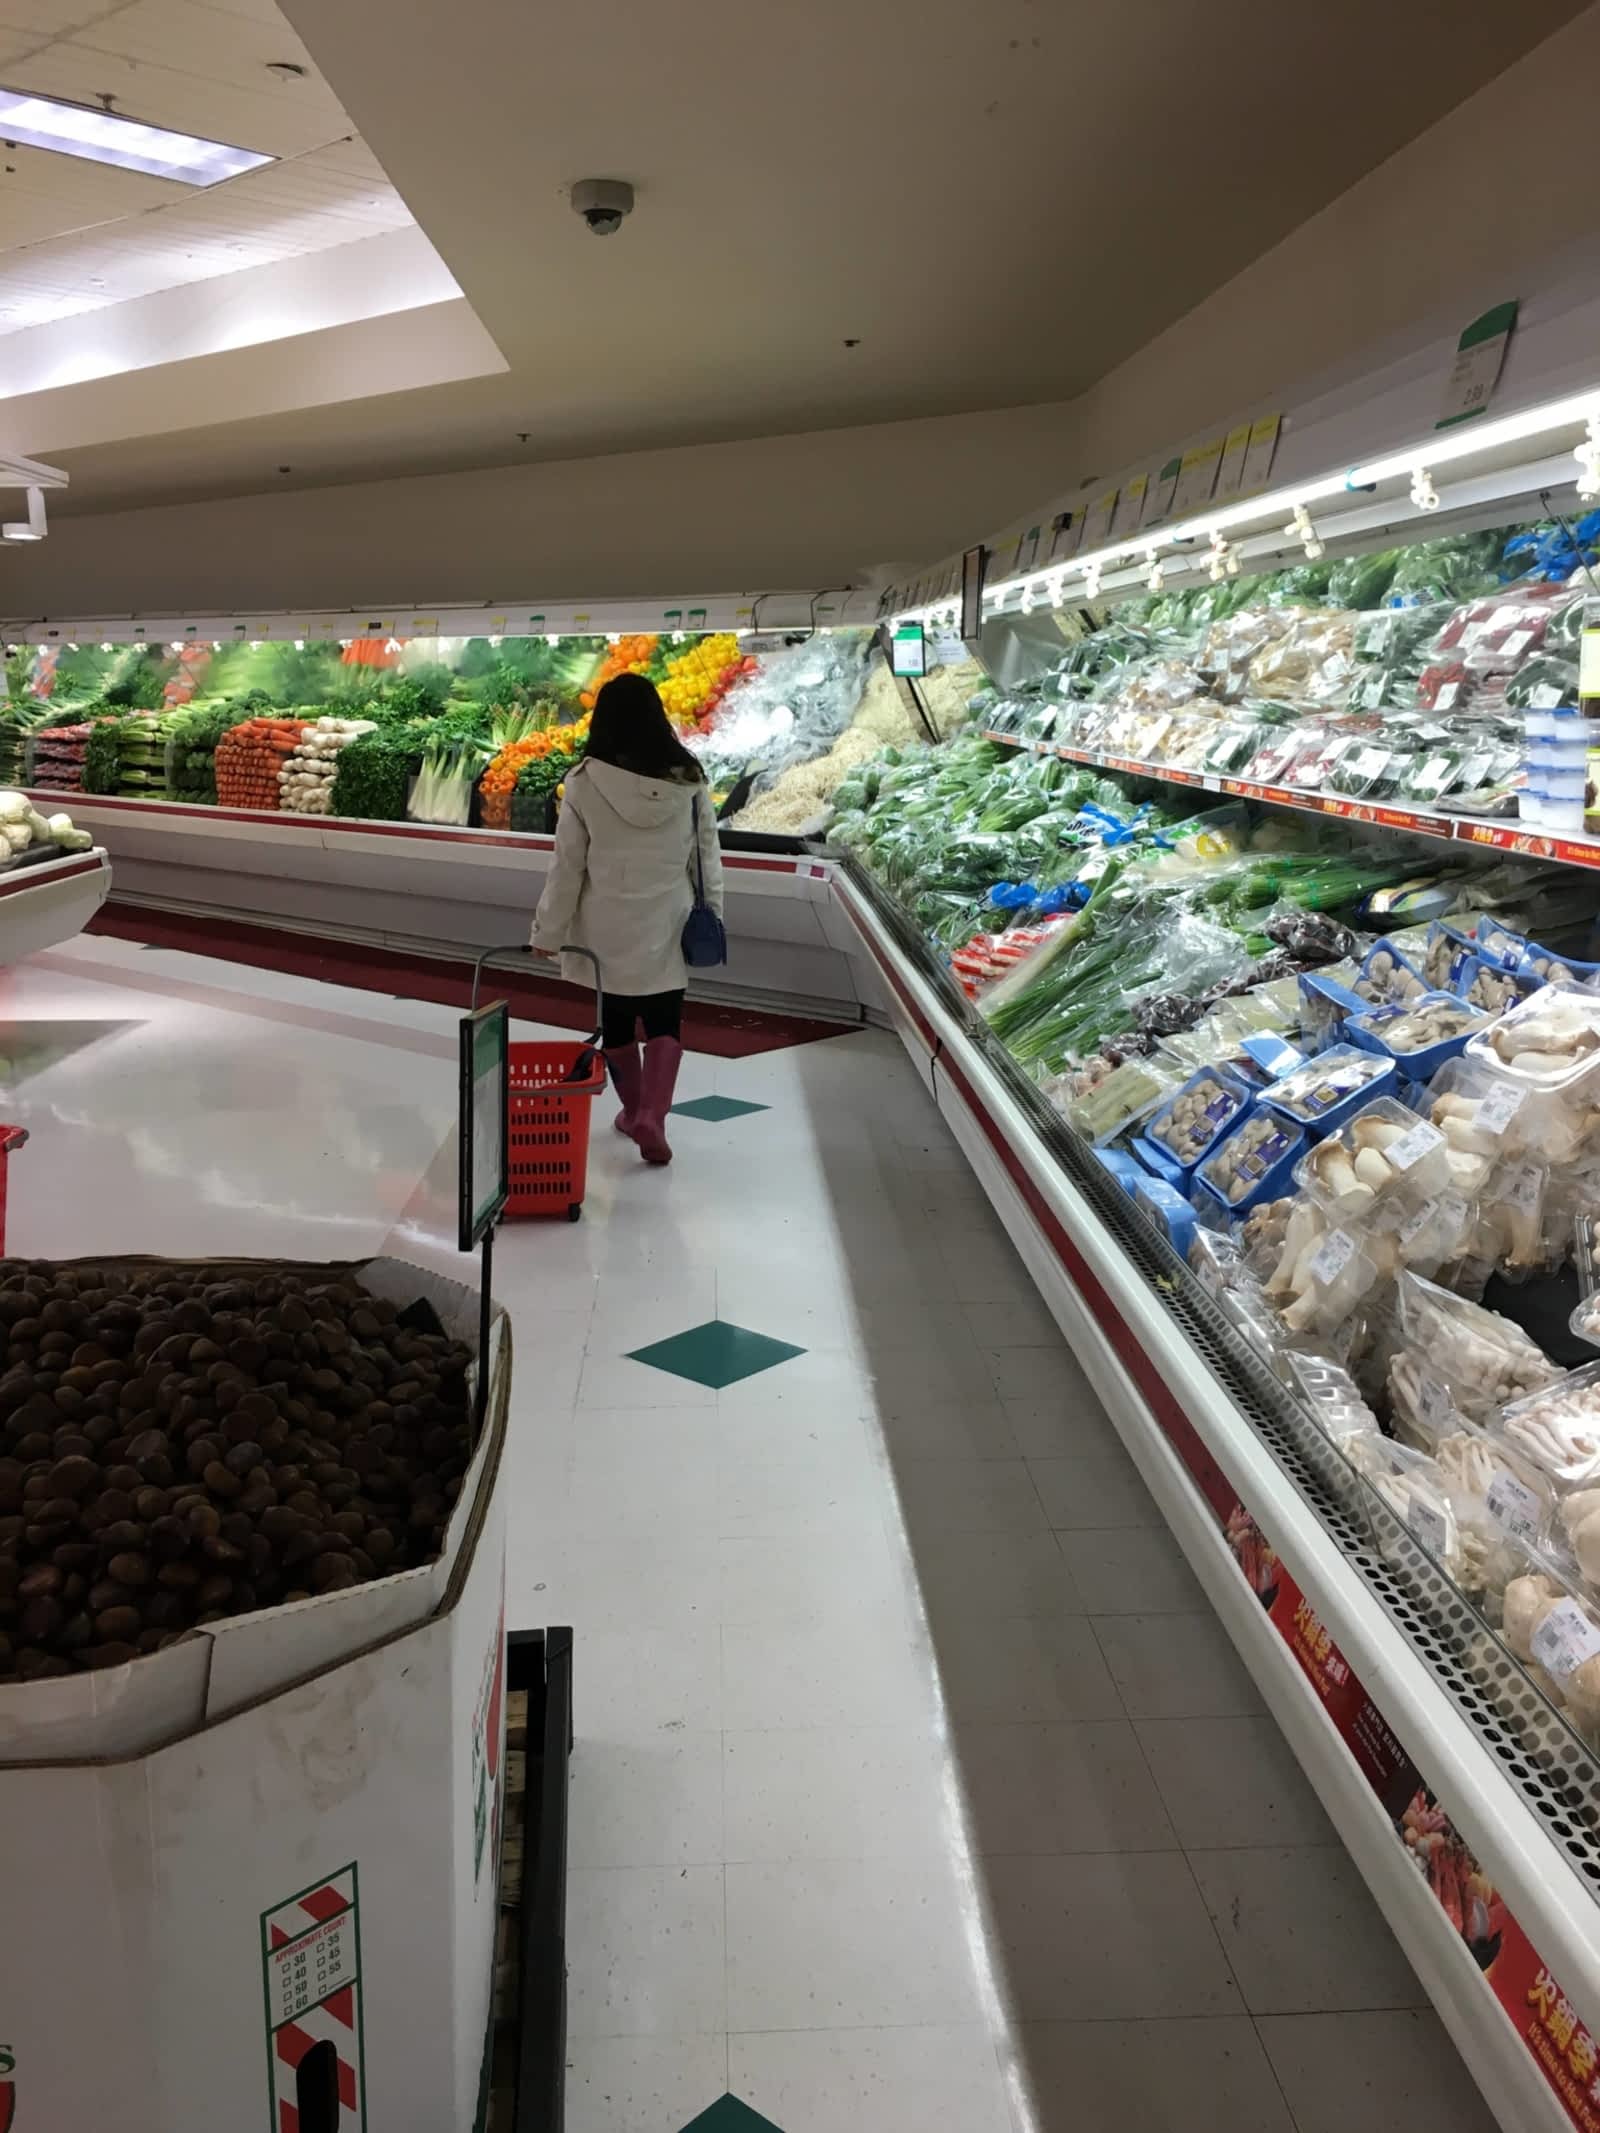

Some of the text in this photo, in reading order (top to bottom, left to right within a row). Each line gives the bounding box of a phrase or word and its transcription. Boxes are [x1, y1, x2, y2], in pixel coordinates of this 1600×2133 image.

[275, 1916, 347, 1963] APPROXIMATE COUNT
[294, 1932, 340, 1967] 30 35
[295, 1946, 341, 1980] 40 45
[295, 1961, 341, 1995] 50 55
[296, 1994, 308, 2009] 60
[1539, 2040, 1558, 2072] time
[1556, 2068, 1567, 2086] to
[1564, 2081, 1583, 2111] Hot
